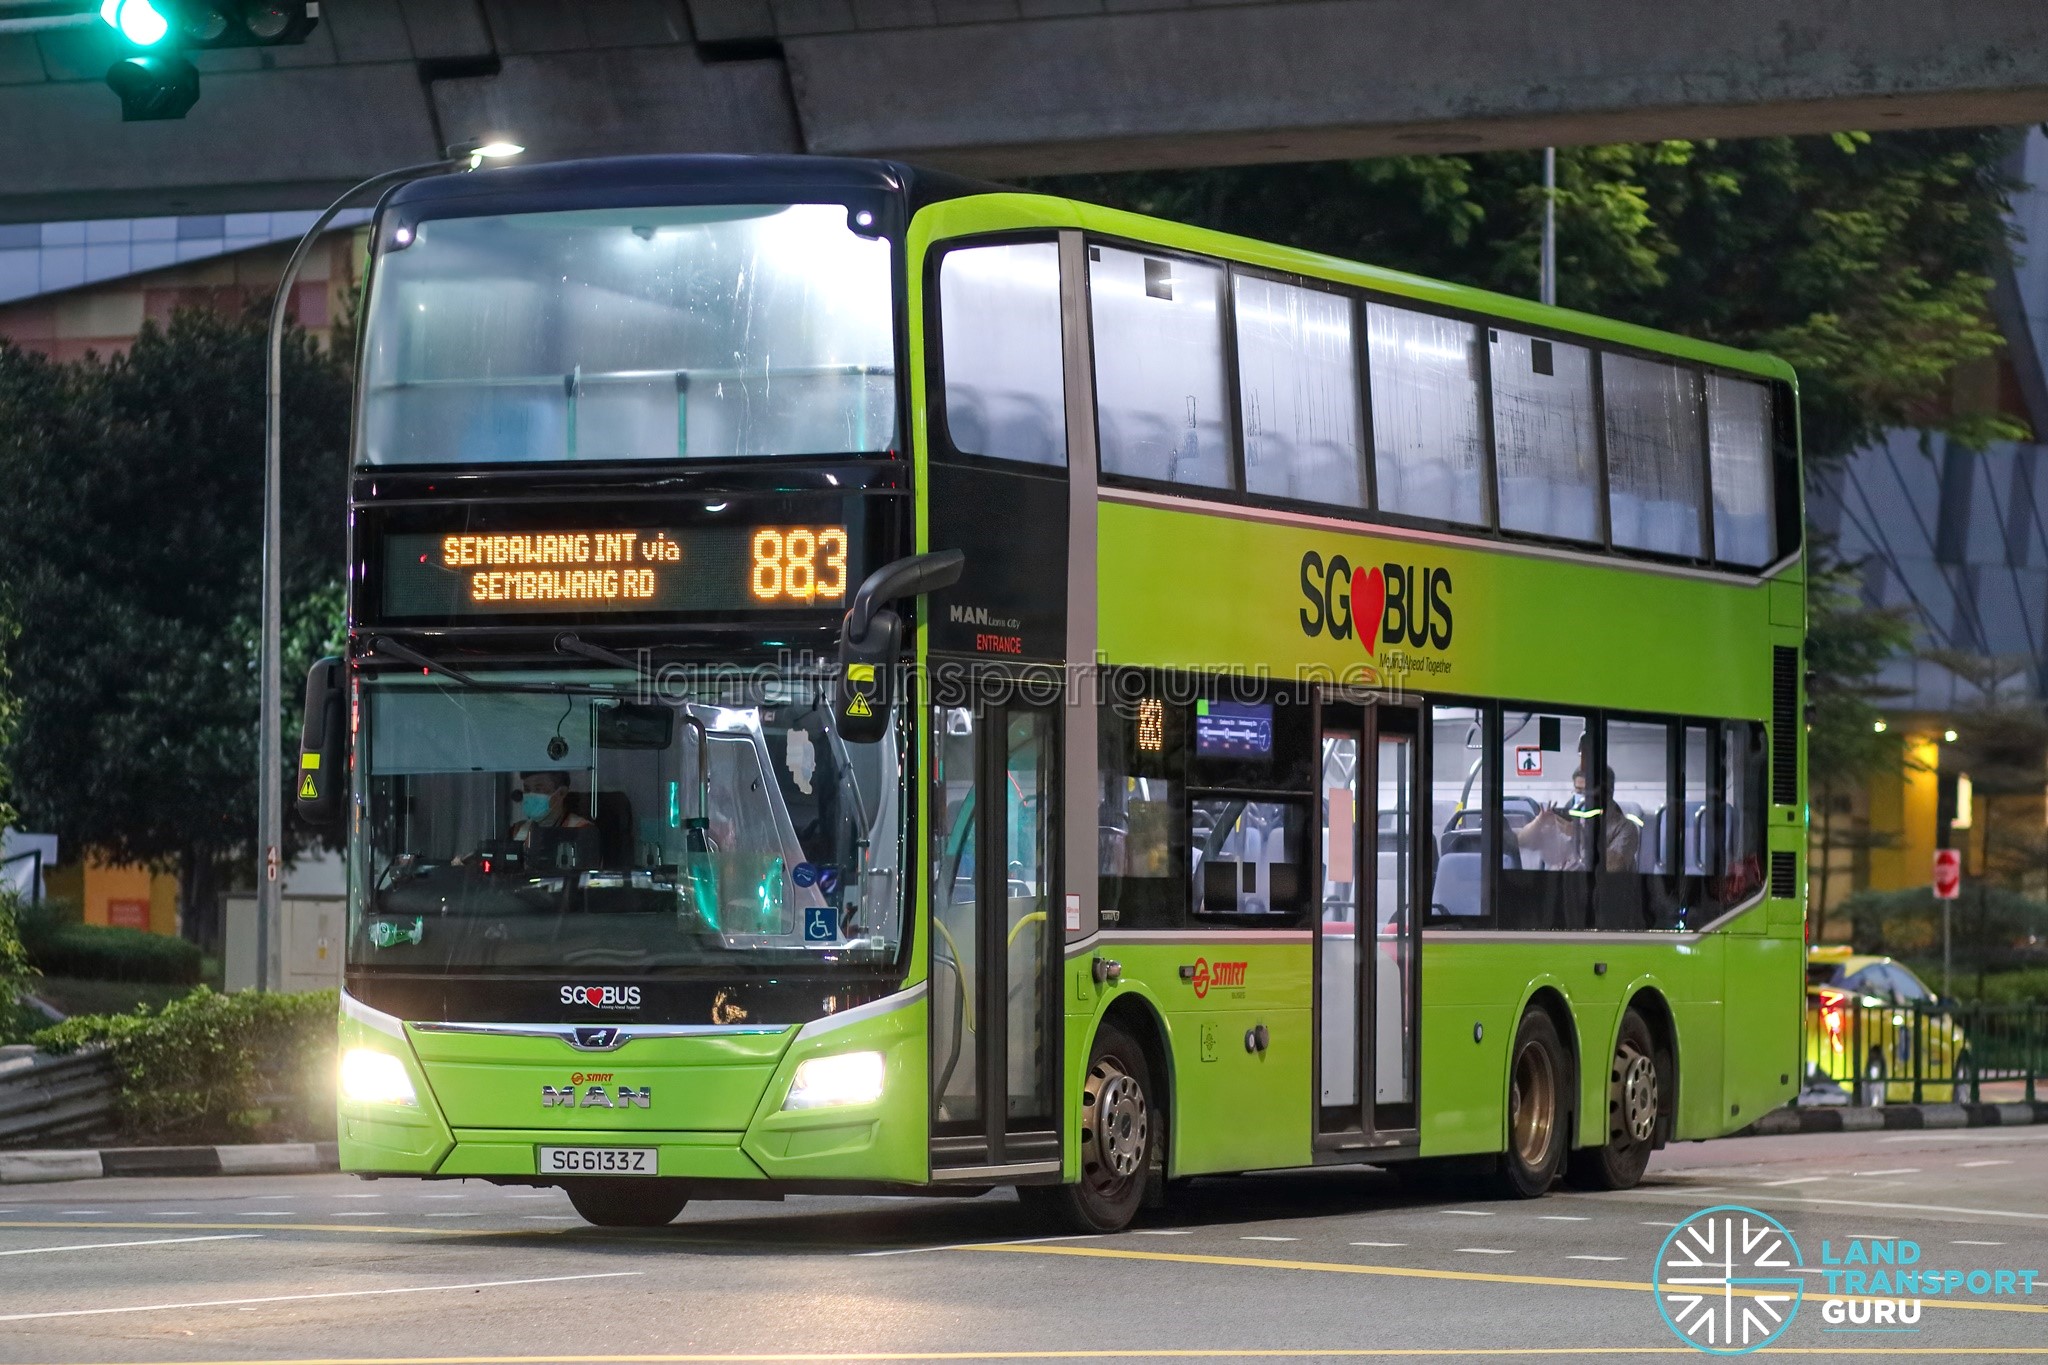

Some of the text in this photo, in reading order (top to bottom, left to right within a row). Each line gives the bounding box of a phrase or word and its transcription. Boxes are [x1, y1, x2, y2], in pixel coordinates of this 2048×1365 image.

[444, 532, 680, 565] SEMBAWANG INT via
[753, 528, 848, 598] 883
[472, 569, 655, 600] SEMBAWANG RD
[950, 604, 988, 626] MAN
[976, 633, 1022, 654] ENTRANCE
[1425, 656, 1452, 676] Together
[1139, 698, 1162, 750] 883
[1210, 961, 1248, 986] SMRT
[585, 1073, 614, 1082] SMRT
[541, 1085, 651, 1109] MAN
[552, 1150, 645, 1171] SG6133Z
